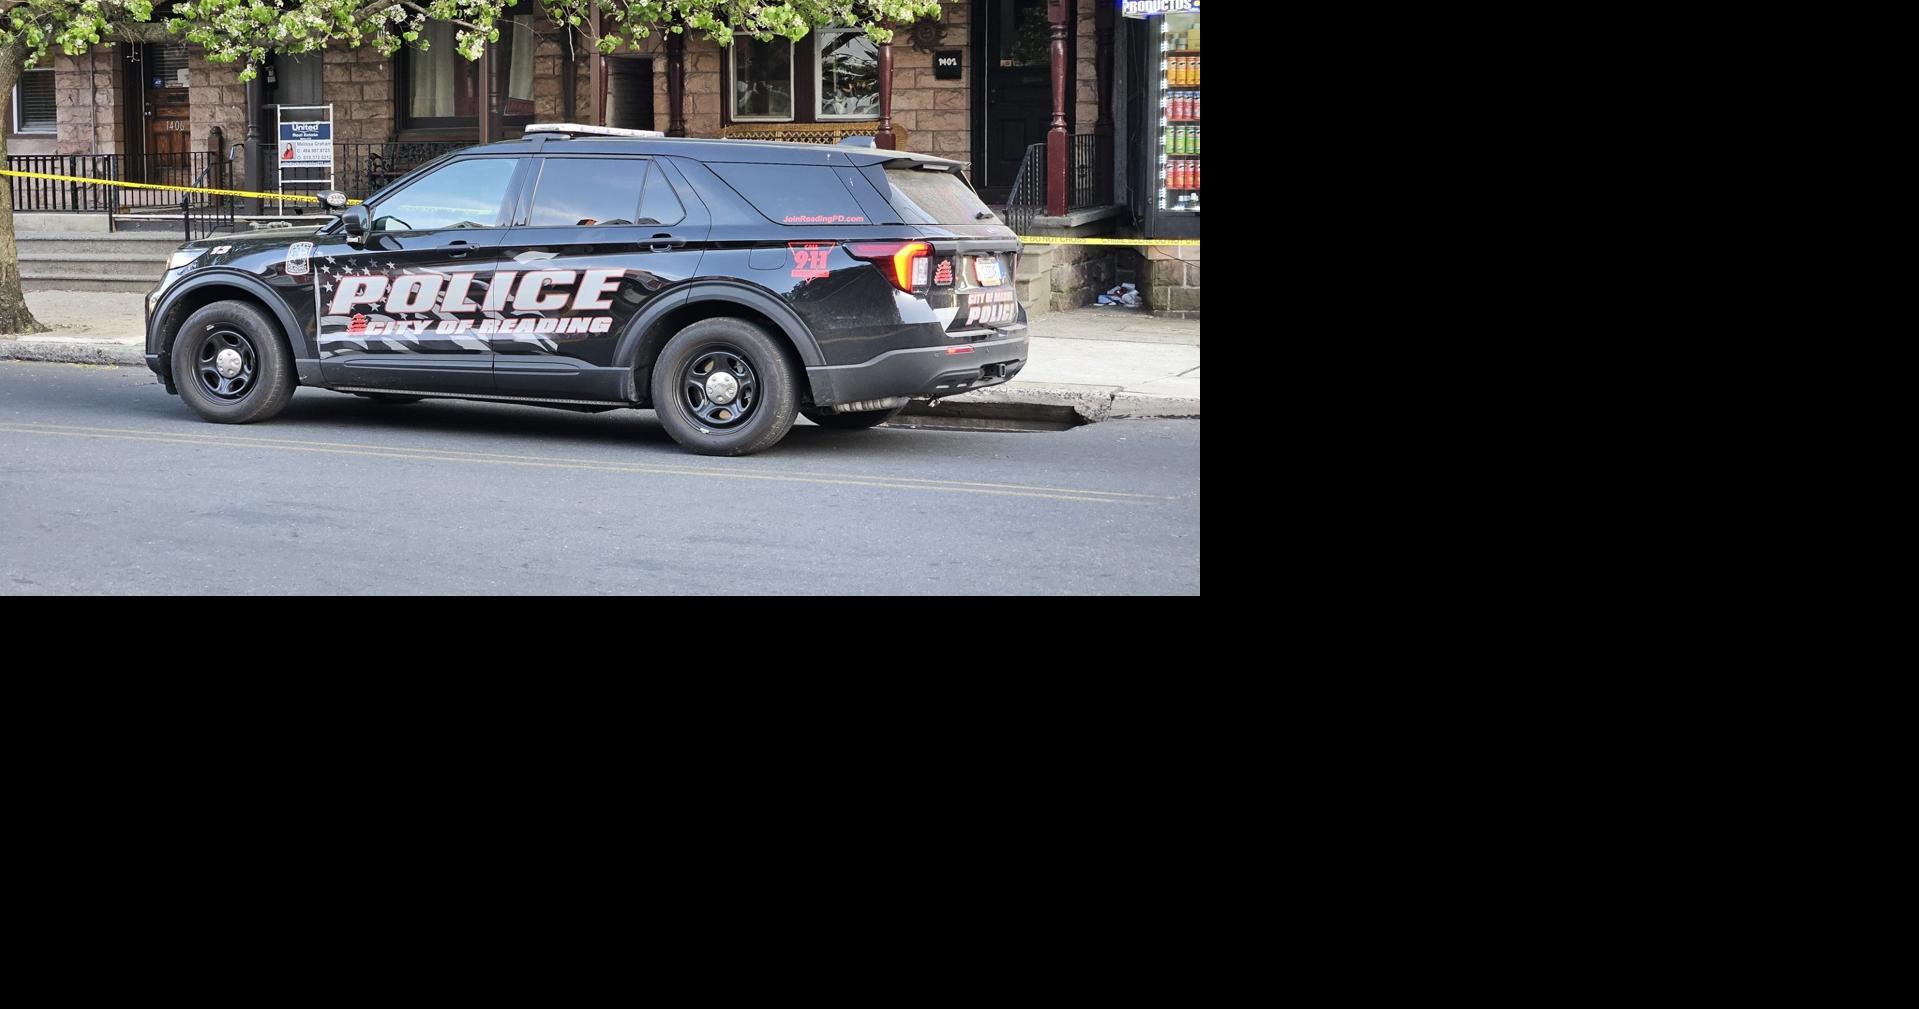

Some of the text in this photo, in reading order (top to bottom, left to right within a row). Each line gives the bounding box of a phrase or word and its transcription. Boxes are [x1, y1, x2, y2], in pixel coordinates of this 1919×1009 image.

[1123, 0, 1192, 13] PRODUCTOS
[166, 120, 185, 131] 1406
[292, 122, 319, 132] United
[783, 215, 864, 224] JoinReadingPD.com
[328, 268, 628, 315] POLICE
[364, 316, 614, 336] CITY OF READING
